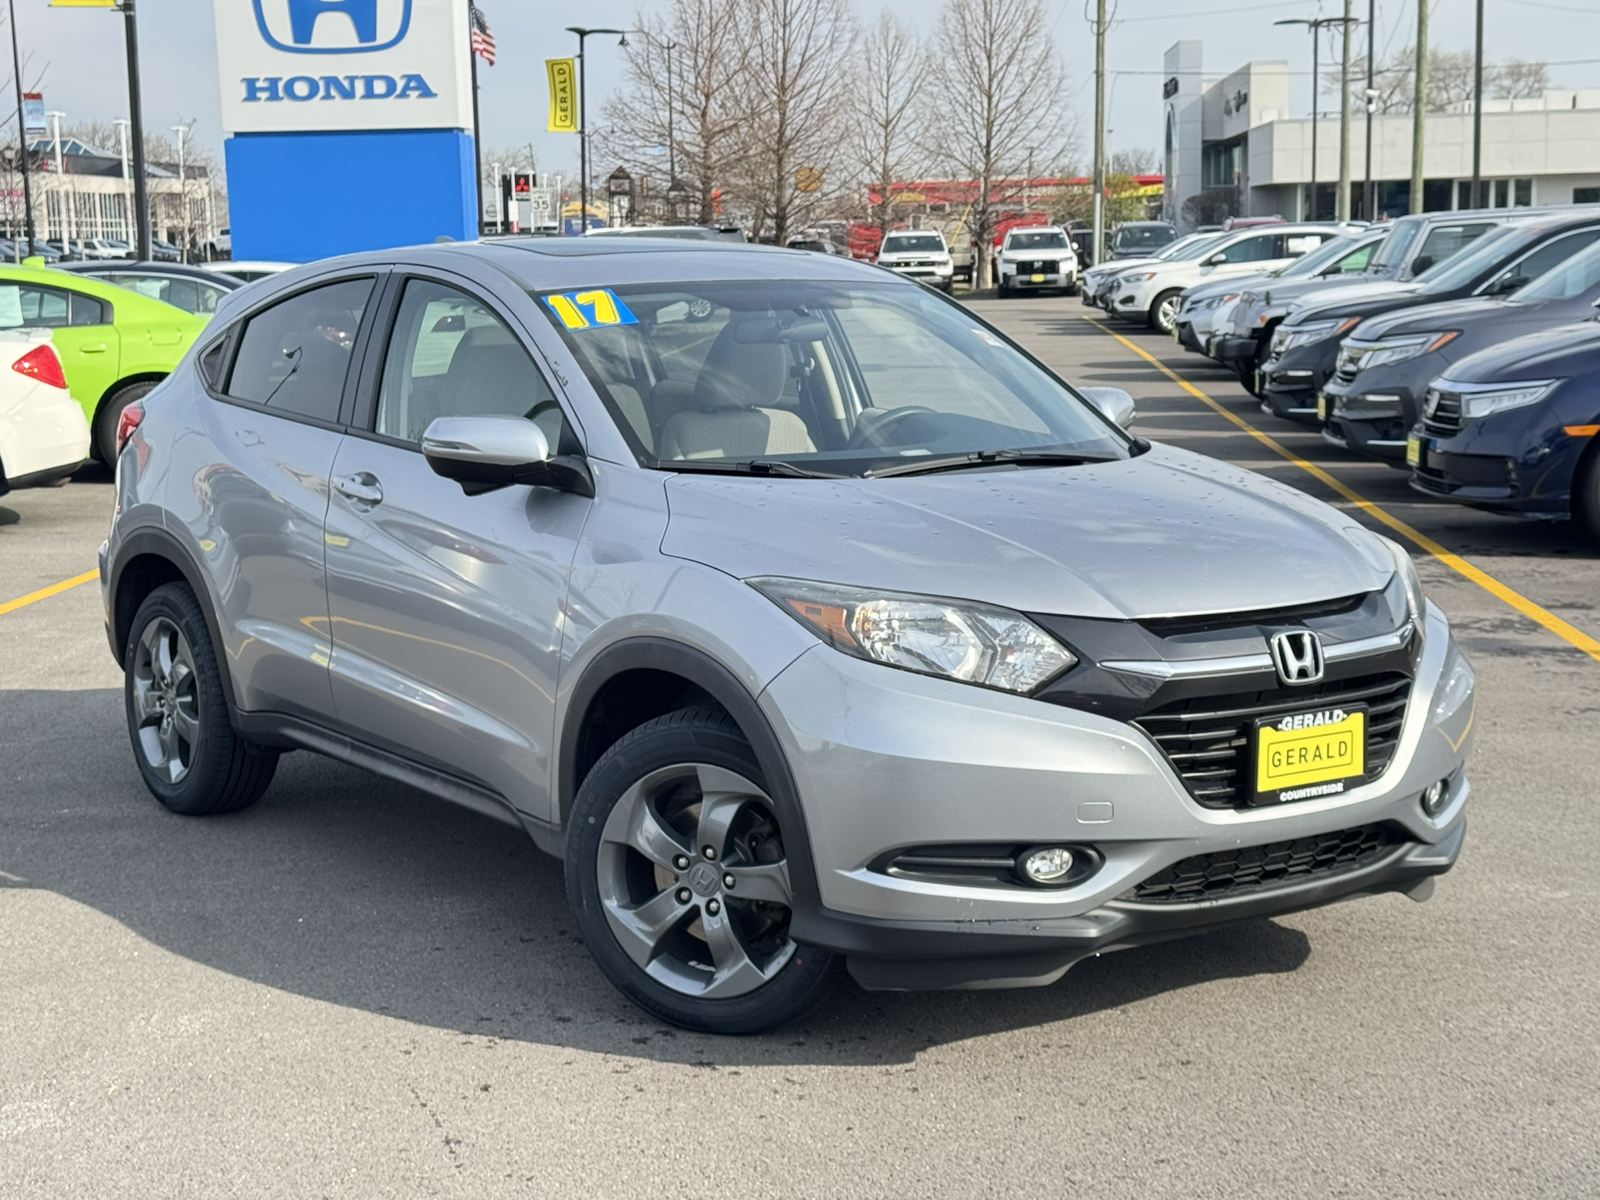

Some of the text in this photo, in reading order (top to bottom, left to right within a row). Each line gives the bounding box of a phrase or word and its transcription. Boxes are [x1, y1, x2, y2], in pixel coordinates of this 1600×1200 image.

[240, 74, 438, 102] HONDA
[557, 67, 569, 122] GERALD
[533, 200, 549, 210] 35
[547, 290, 621, 328] 17
[1280, 709, 1345, 732] GERALD
[1271, 740, 1348, 768] GERALD
[1279, 782, 1344, 802] COUNTRYSIDE
